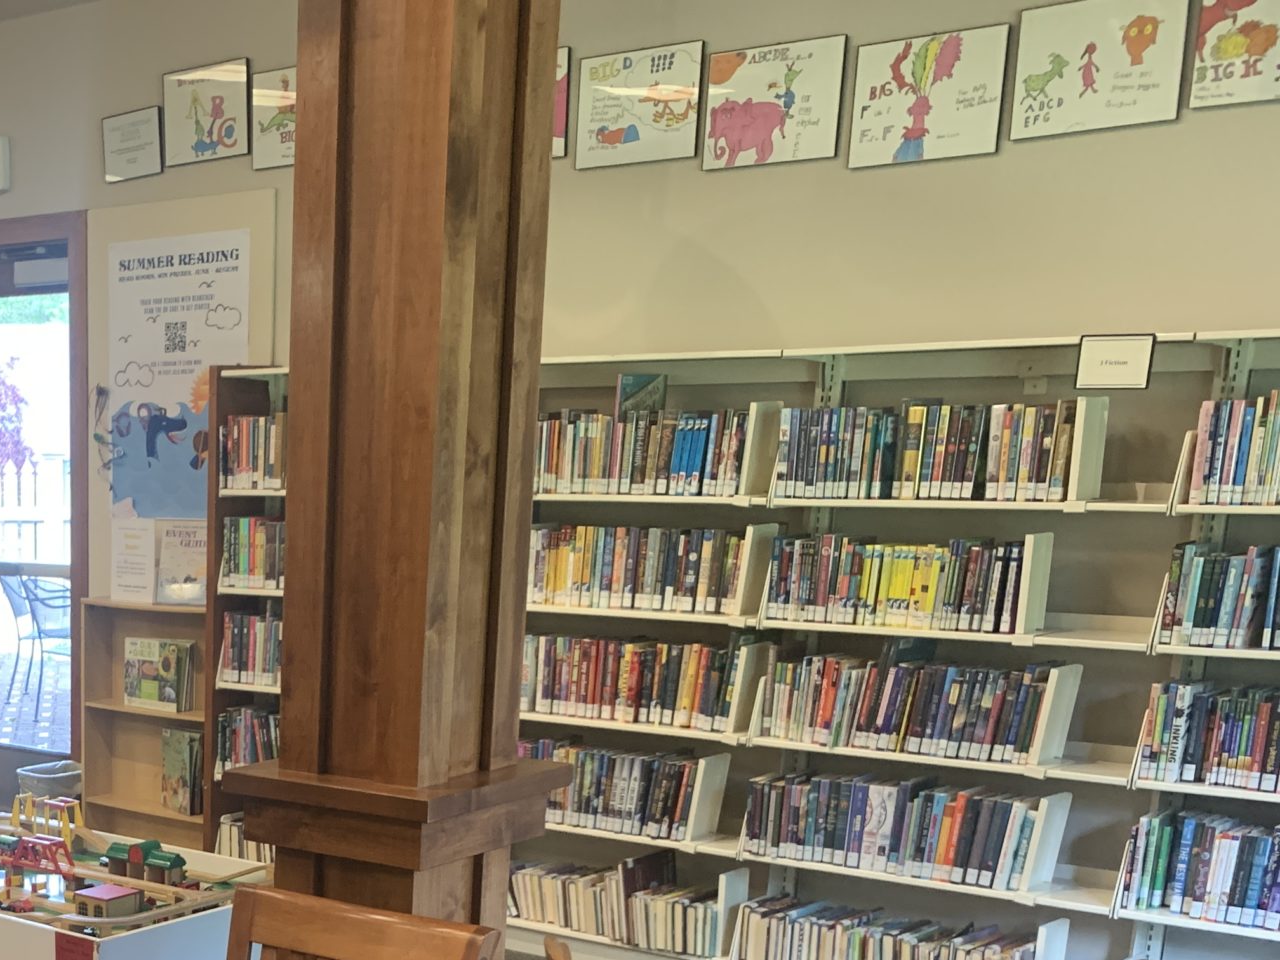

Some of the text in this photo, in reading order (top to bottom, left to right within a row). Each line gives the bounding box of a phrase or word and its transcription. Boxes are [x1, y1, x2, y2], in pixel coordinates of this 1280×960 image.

[588, 57, 620, 82] BIG
[623, 56, 633, 70] D
[1194, 62, 1235, 84] BIG
[869, 82, 893, 101] BIG
[118, 248, 240, 272] SUMMER READING
[166, 529, 197, 539] EVENT
[179, 539, 206, 548] GUID
[1168, 724, 1182, 763] INKLING
[1175, 863, 1187, 880] BEST
